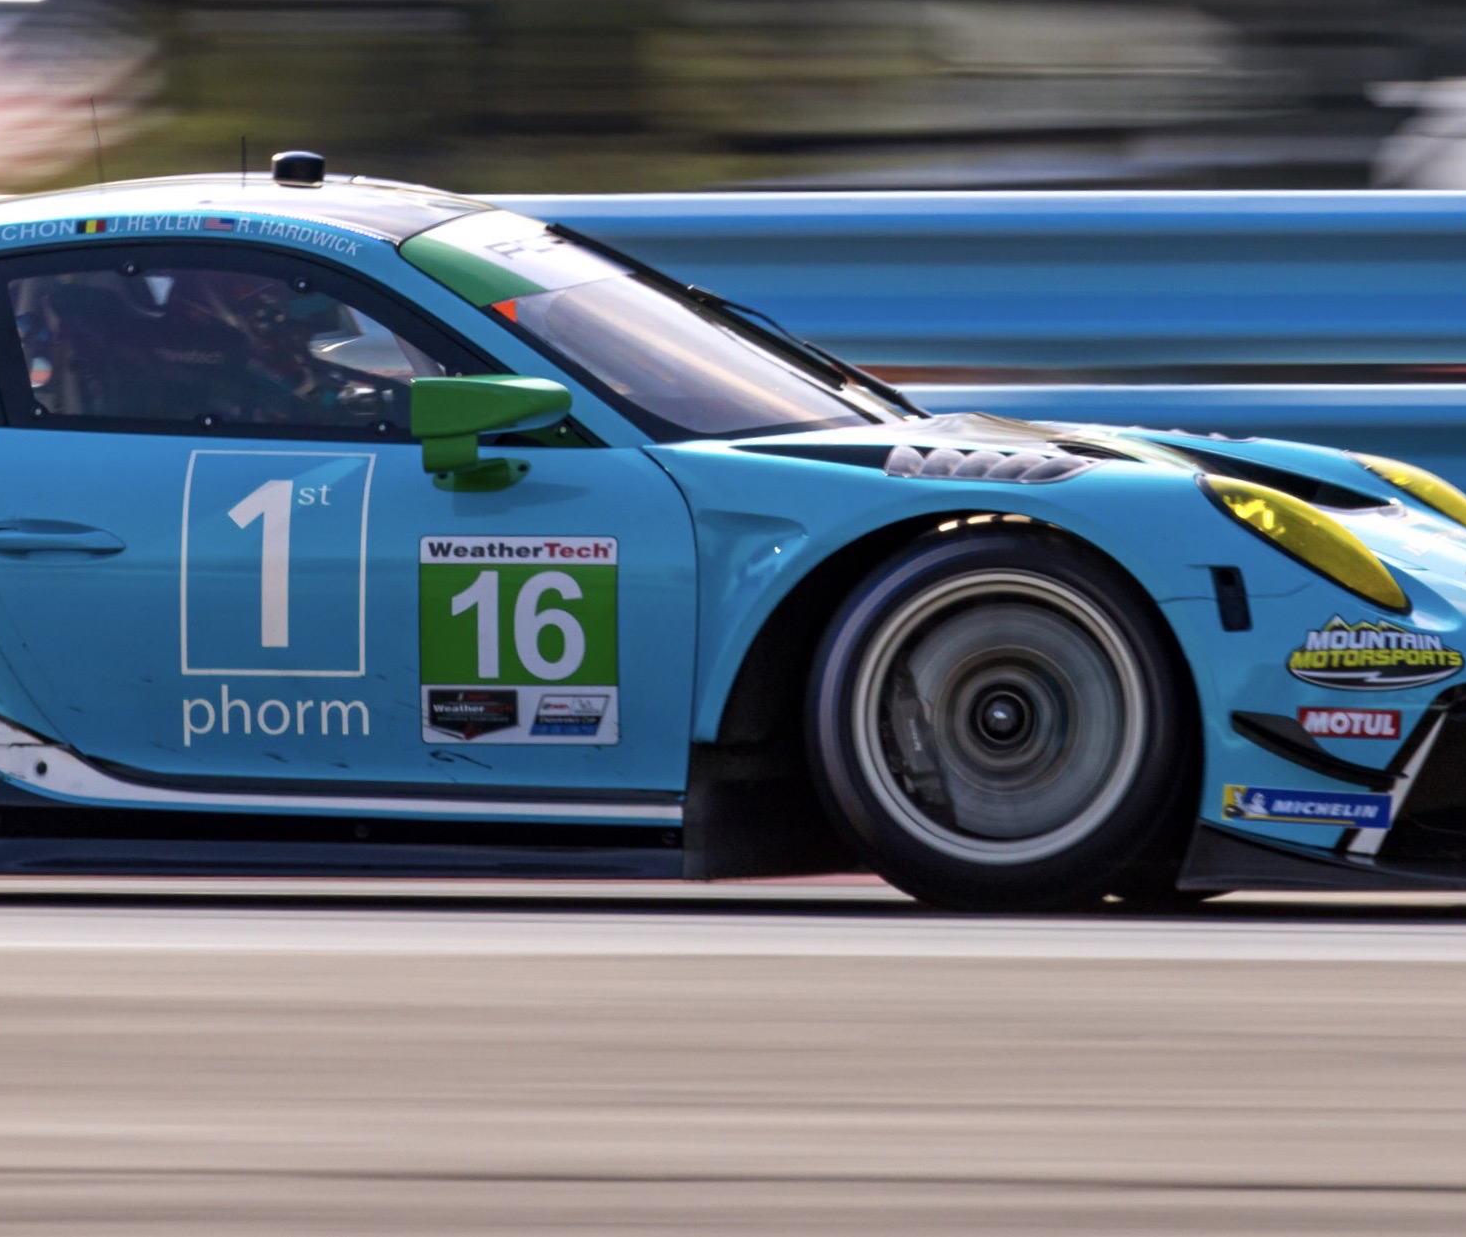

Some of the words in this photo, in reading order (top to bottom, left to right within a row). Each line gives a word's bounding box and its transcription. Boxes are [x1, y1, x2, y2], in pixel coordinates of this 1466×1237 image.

[126, 214, 201, 232] HEYLEN
[237, 216, 254, 234] R.
[258, 220, 363, 257] HARDWICK
[428, 541, 610, 559] WeatherTech
[451, 570, 586, 681] 16
[1306, 629, 1443, 651] MOUNTAIN
[1289, 650, 1464, 669] MOTORSPORTS
[183, 684, 369, 746] phorm
[1302, 710, 1396, 736] MOTUL
[1271, 799, 1379, 819] MICHELIN
